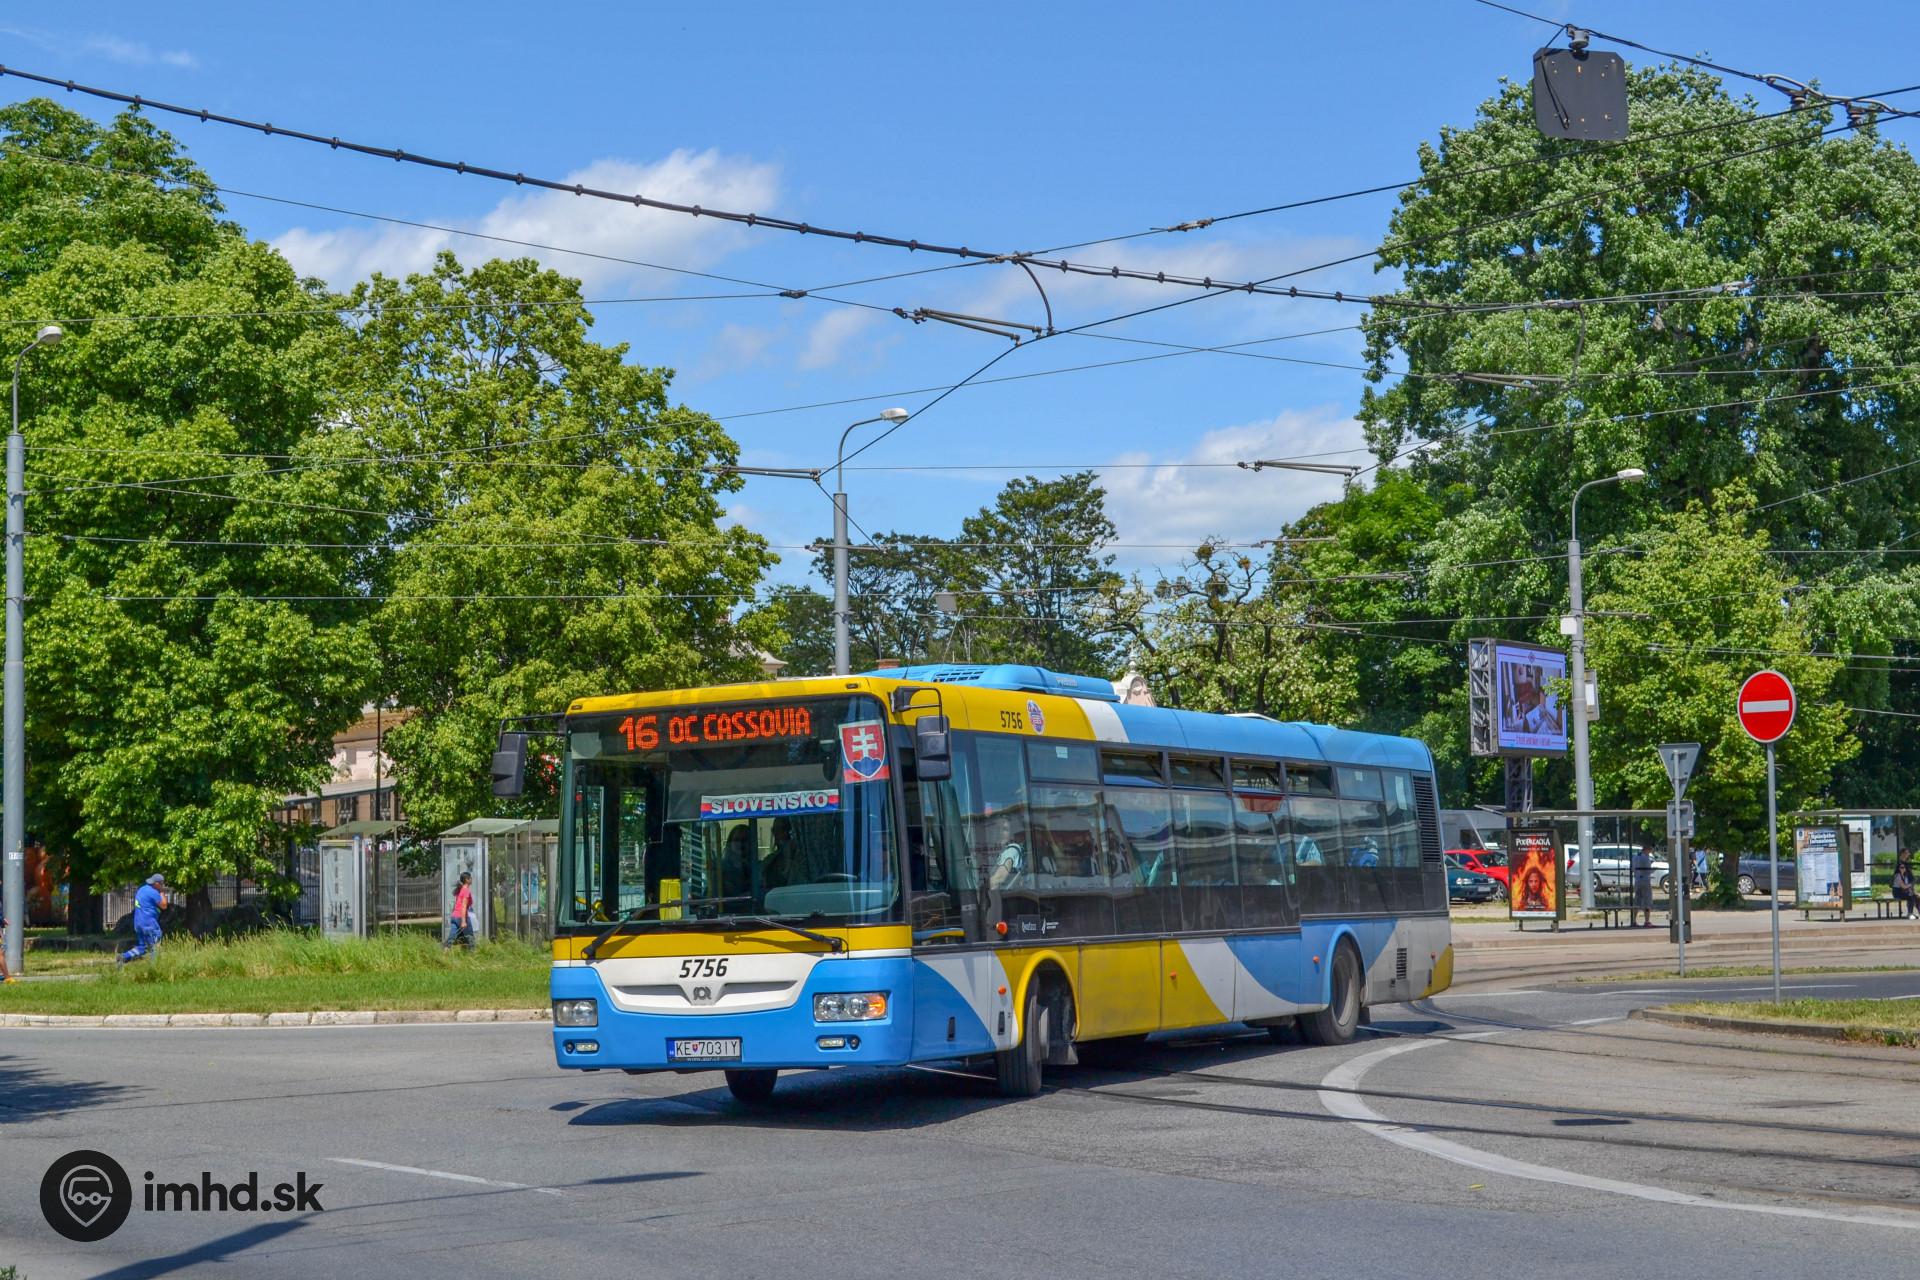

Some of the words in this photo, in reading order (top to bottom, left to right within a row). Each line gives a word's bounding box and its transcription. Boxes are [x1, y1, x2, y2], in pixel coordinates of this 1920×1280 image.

[618, 714, 660, 750] 16
[668, 715, 699, 744] OC
[703, 706, 811, 741] CASSOVIA
[999, 710, 1023, 730] 5756
[711, 792, 828, 814] SLOVENSKO
[679, 958, 729, 978] 5756
[676, 1041, 692, 1056] KE
